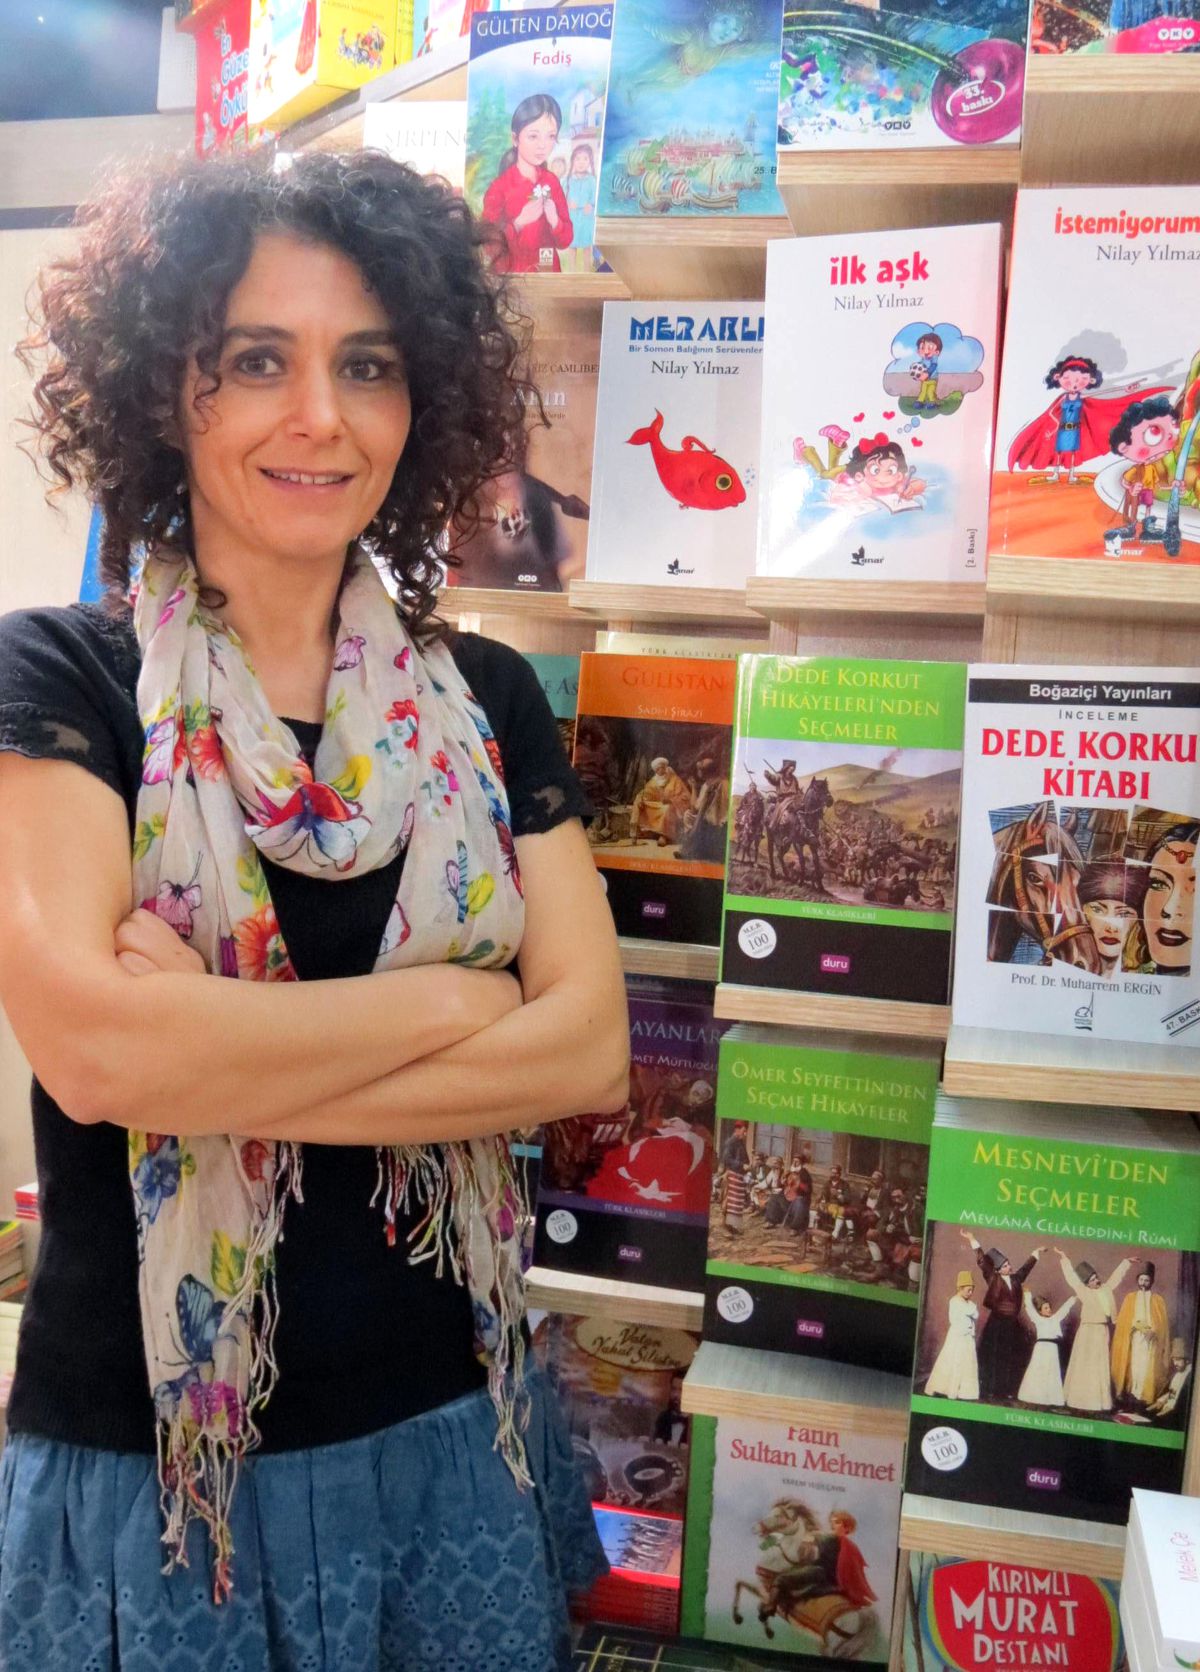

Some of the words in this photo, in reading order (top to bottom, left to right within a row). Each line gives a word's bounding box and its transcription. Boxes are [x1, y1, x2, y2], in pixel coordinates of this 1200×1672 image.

[477, 15, 540, 37] GÜLTEN
[532, 51, 572, 67] Fadiş
[1054, 206, 1200, 239] İstemiyorum
[1096, 244, 1141, 266] Nilay
[829, 255, 867, 286] ilk
[876, 250, 930, 289] aşk
[834, 295, 872, 313] Nilay
[876, 293, 925, 309] Yılmaz
[628, 344, 643, 354] Bir
[643, 344, 674, 354] Somon
[650, 360, 689, 379] Nilay
[692, 360, 740, 375] Yılmaz
[777, 665, 831, 685] DEDE
[837, 668, 923, 690] KORKUT
[1029, 684, 1098, 702] Boğaziçi
[1101, 686, 1173, 702] Yayınları
[1058, 709, 1139, 722] İNCELEME
[798, 717, 898, 741] SEÇMELER
[981, 728, 1066, 758] DEDE
[1078, 731, 1198, 763] KORKU
[1042, 760, 1151, 800] KİTABI
[643, 904, 665, 915] duru
[748, 932, 769, 951] 100
[823, 957, 848, 970] duru
[1011, 972, 1038, 985] Prof.
[1041, 975, 1057, 987] Dr.
[1061, 976, 1120, 993] Muharrem
[1123, 981, 1162, 997] ERGİN
[731, 1057, 787, 1083] ÖMER
[746, 1086, 805, 1111] SEÇME
[996, 1177, 1142, 1219] SEÇMELER
[554, 1222, 572, 1237] 100
[619, 1248, 642, 1259] duru
[726, 1300, 747, 1316] 100
[798, 1323, 823, 1336] duru
[730, 1438, 797, 1468] Sultan
[803, 1449, 896, 1482] Mehmet
[934, 1442, 959, 1461] 100
[1028, 1471, 1059, 1486] duru
[987, 1563, 1070, 1596] KIRIMLI
[950, 1587, 1079, 1636] MURAT
[973, 1633, 1069, 1666] DESTANI
